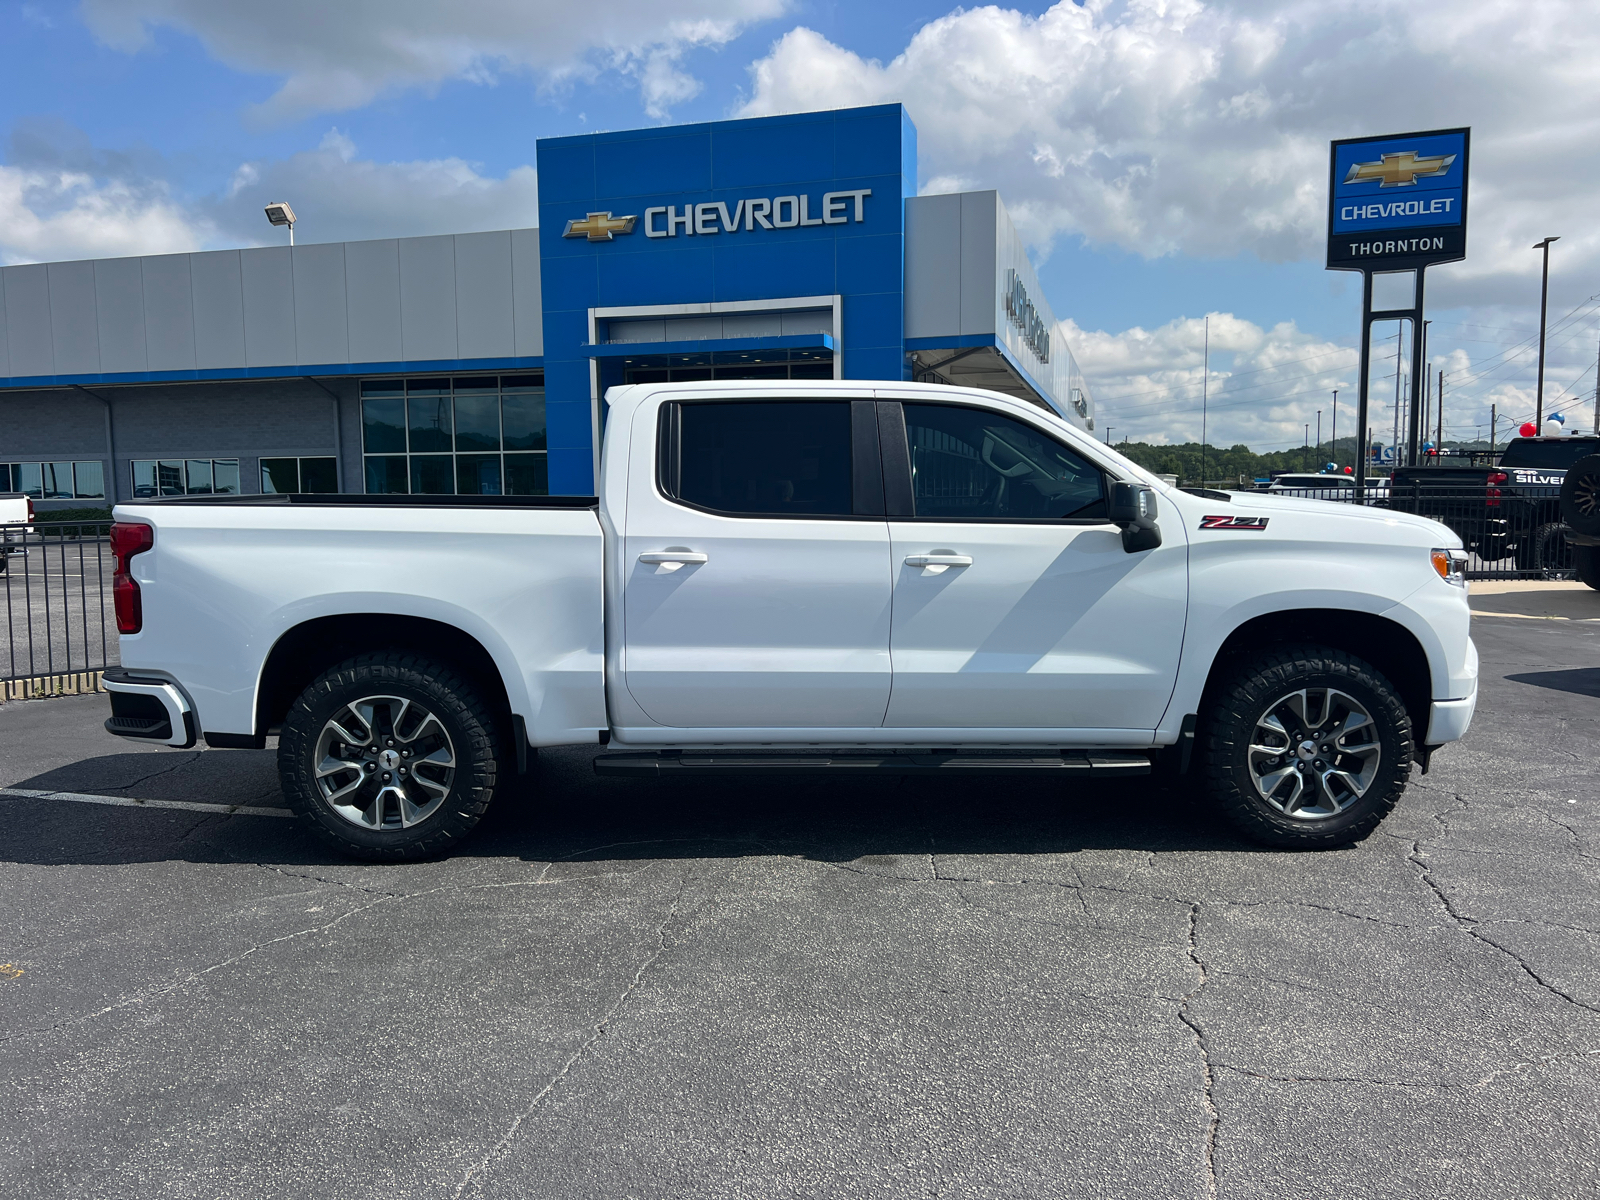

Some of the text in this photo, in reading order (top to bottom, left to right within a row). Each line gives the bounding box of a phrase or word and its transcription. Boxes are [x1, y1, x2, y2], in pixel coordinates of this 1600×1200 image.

[644, 188, 872, 238] CHEVROLET
[1341, 198, 1455, 221] CHEVROLET
[1349, 237, 1444, 256] THORNTON
[1198, 515, 1270, 531] Z71
